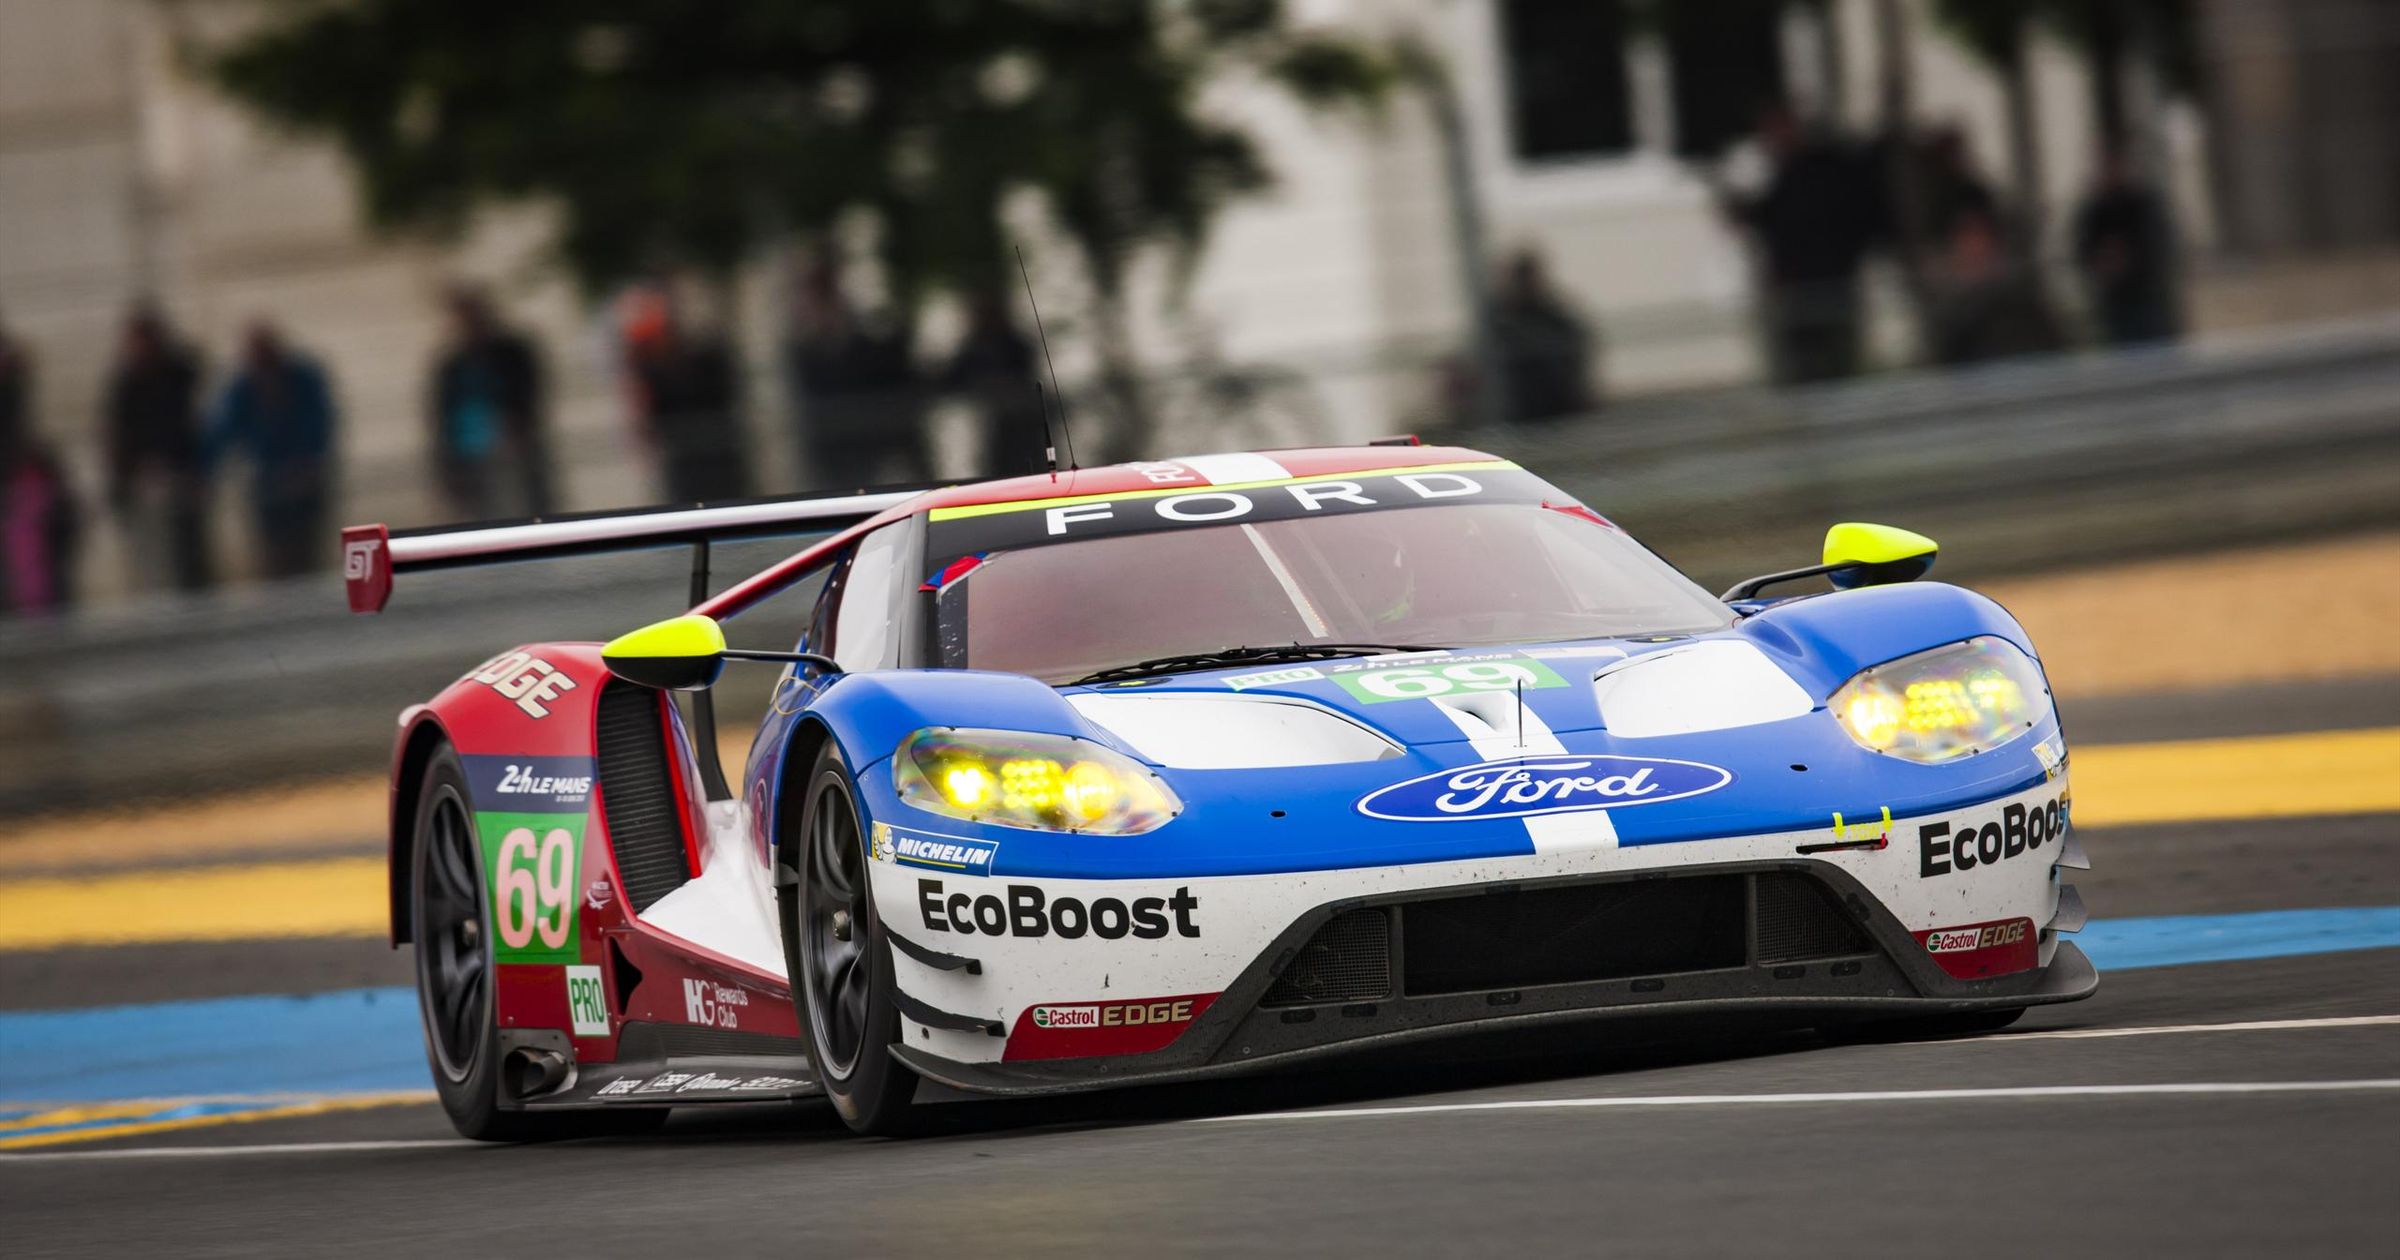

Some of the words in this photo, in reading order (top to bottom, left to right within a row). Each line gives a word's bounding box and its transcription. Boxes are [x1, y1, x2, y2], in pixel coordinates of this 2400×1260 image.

[1046, 472, 1483, 536] FORD
[345, 540, 381, 582] GT
[461, 652, 577, 718] DGE
[1228, 669, 1314, 688] PRO
[1357, 662, 1538, 698] 69
[550, 777, 592, 794] MANS
[1435, 761, 1660, 813] Ford
[897, 837, 992, 866] MICHELIN
[497, 827, 575, 950] 69
[918, 878, 1201, 939] EcoBoost
[1940, 929, 1977, 950] Castrol
[1979, 919, 2029, 949] EDGE
[570, 978, 605, 1024] PRO
[683, 978, 715, 1026] IHG
[713, 981, 748, 1007] Rewards
[1048, 1007, 1096, 1027] Castrol
[1102, 1000, 1194, 1026] EDGE
[717, 1005, 738, 1028] Club
